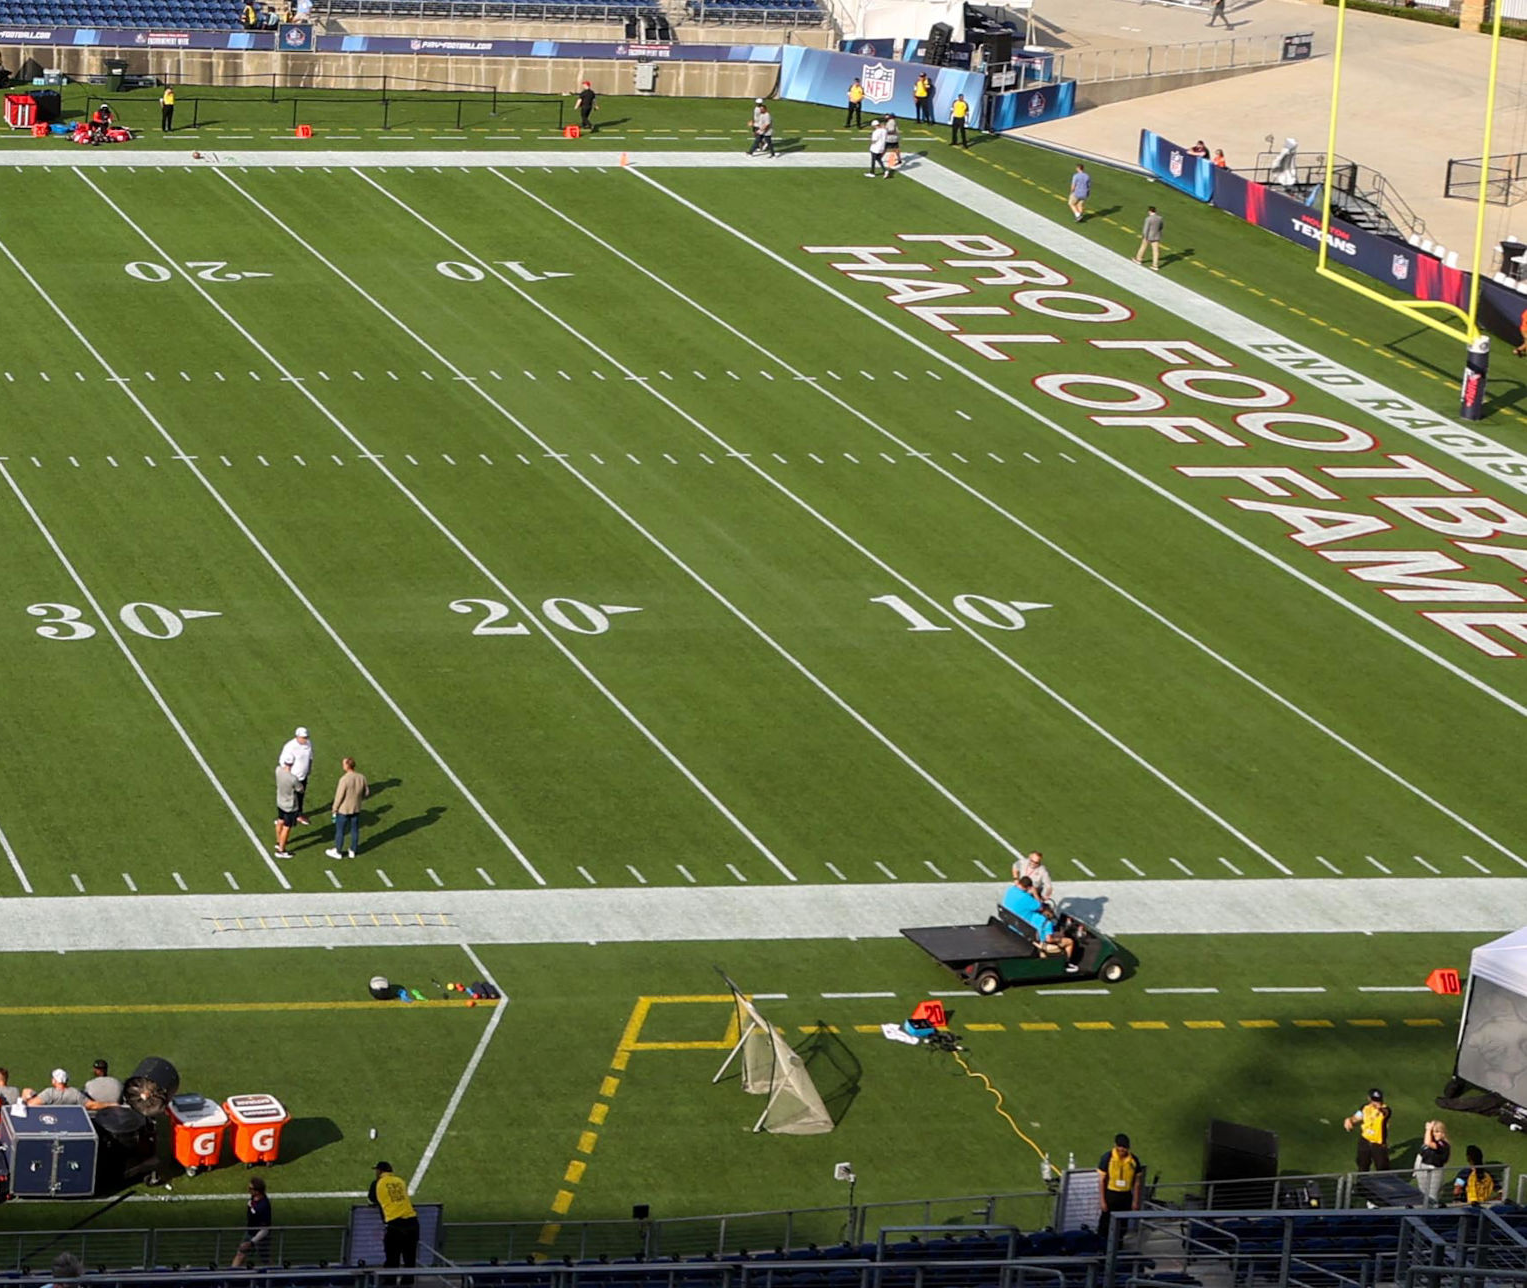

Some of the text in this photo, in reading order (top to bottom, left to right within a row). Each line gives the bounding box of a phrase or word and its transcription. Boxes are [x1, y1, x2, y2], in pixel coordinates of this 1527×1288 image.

[866, 81, 888, 97] NFL
[1291, 218, 1357, 256] TEXANS
[1300, 214, 1351, 240] HOUTON
[896, 234, 1135, 323] PRO
[801, 245, 1065, 362] HALL
[1032, 373, 1250, 447] OF
[1252, 343, 1365, 386] END
[1440, 972, 1458, 993] 10
[924, 1004, 944, 1025] 20
[193, 1132, 215, 1156] G
[252, 1128, 275, 1152] G
